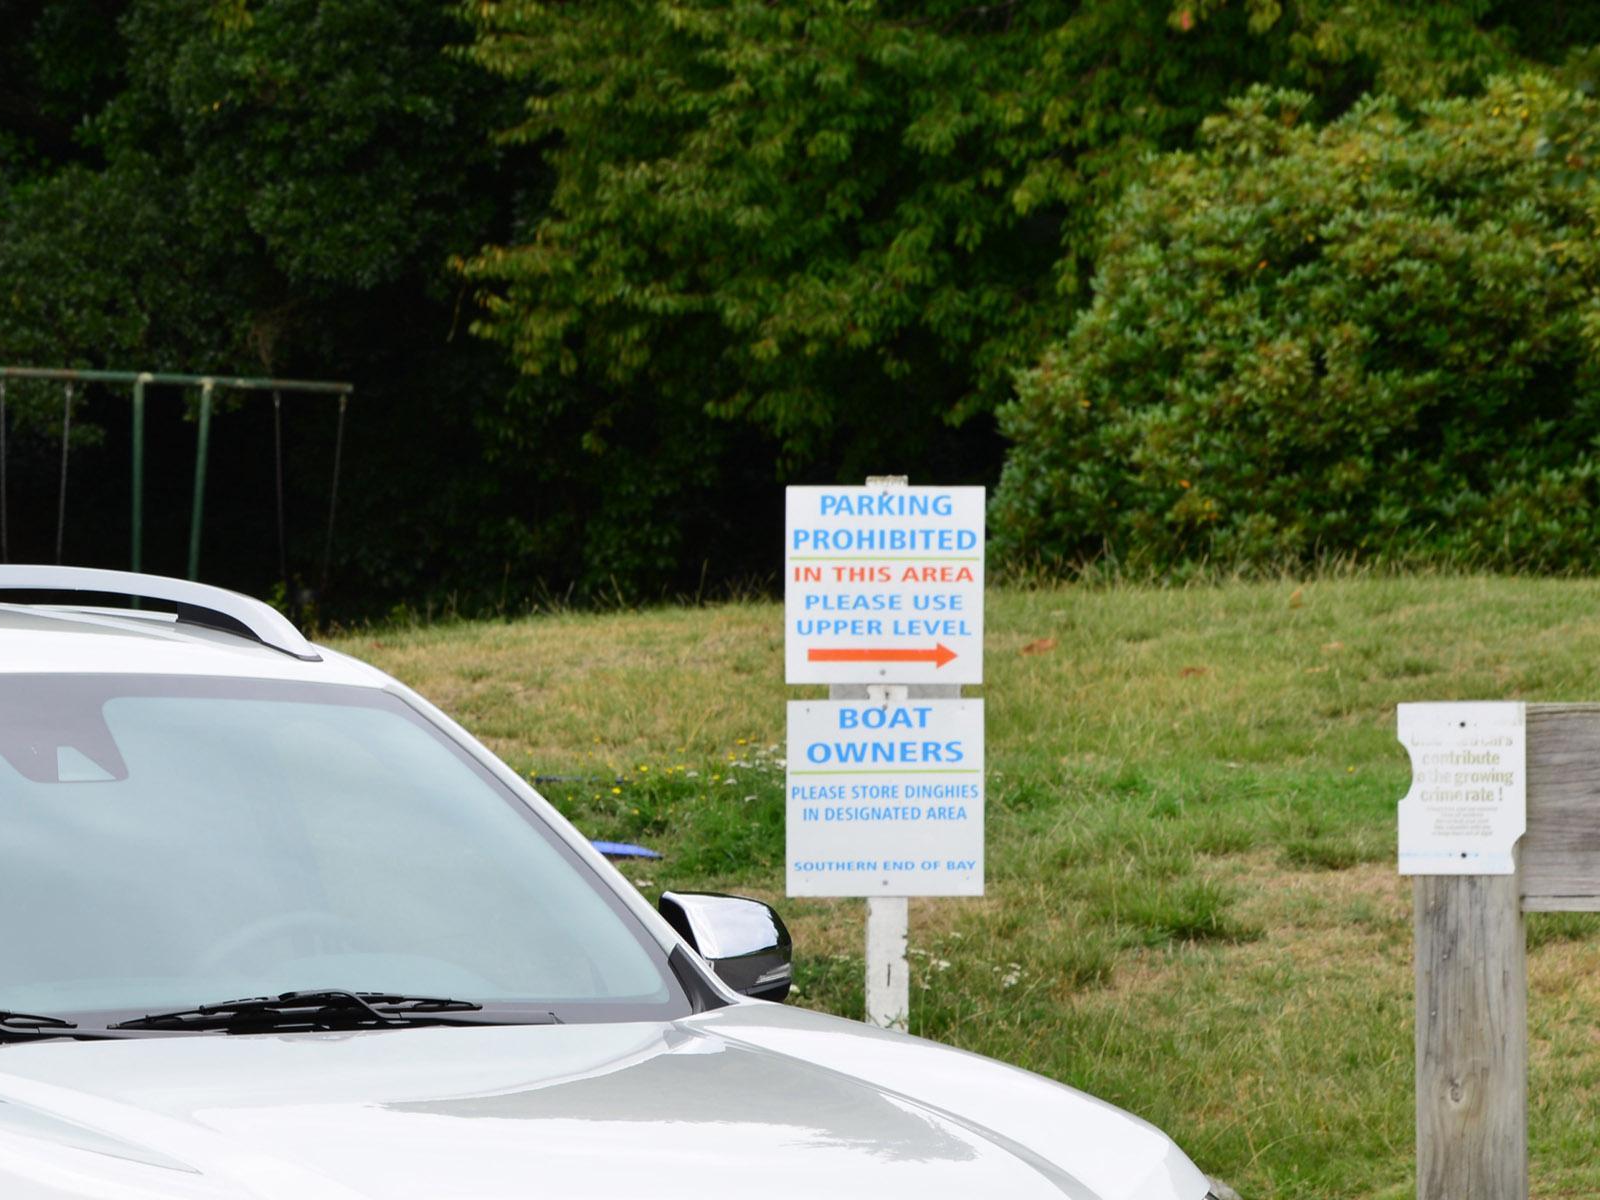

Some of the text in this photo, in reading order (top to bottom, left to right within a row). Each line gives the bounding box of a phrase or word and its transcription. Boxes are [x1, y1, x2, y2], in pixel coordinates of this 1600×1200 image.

[820, 494, 953, 517] PARKING
[792, 529, 978, 551] PROHIBITED
[794, 566, 974, 583] IN THIS AREA
[804, 594, 962, 611] PLEASE USE
[796, 619, 971, 636] UPPER LEVEL
[838, 706, 933, 730] BOAT
[806, 740, 965, 764] OWNERS
[1422, 751, 1500, 765] contribute
[1454, 768, 1514, 786] growing
[791, 784, 979, 800] PLEASE STORE DINGHIES
[1420, 787, 1463, 801] crime
[1465, 787, 1494, 801] rate
[803, 806, 967, 821] IN DESIGNATED AREA
[794, 860, 977, 872] SOUTHERN END OF BAY
